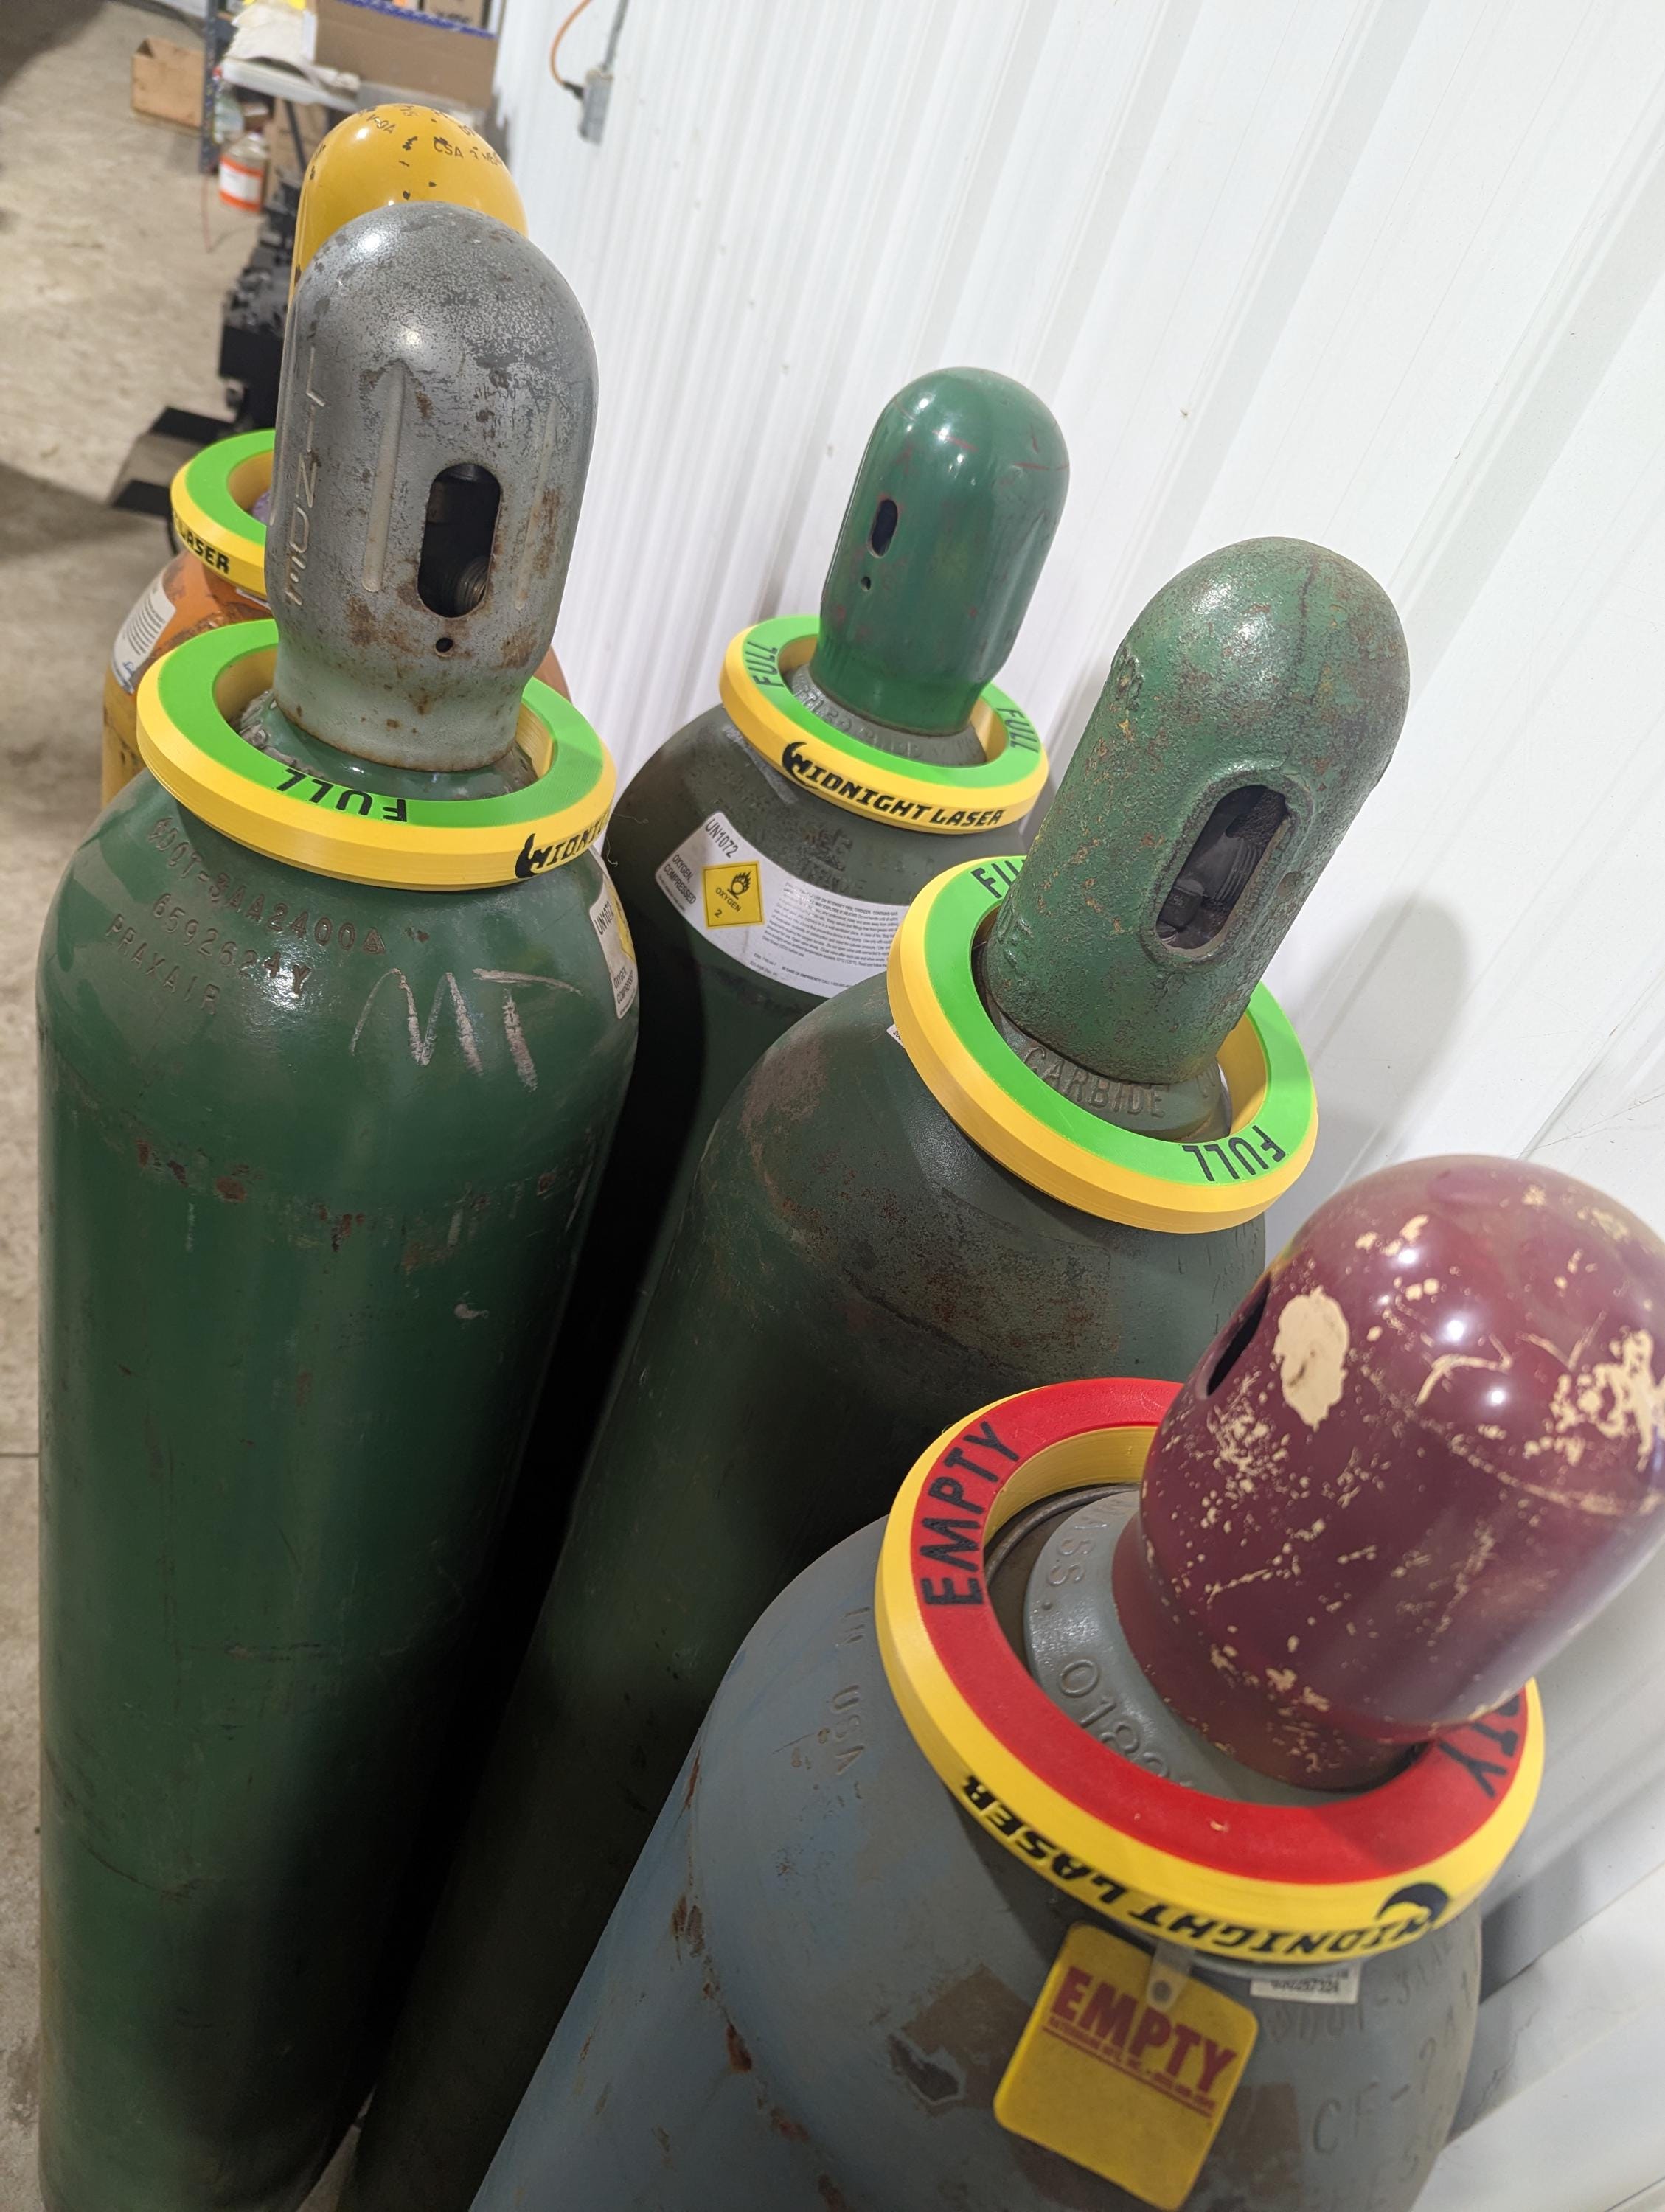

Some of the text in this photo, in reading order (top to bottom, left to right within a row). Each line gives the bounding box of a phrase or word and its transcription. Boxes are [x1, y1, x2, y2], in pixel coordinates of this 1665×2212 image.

[745, 641, 784, 688] FULL
[996, 706, 1040, 753] FULL
[277, 766, 407, 824] FULL
[788, 751, 1007, 827] MIDNIGHT LASER
[705, 818, 739, 858] UN1072
[664, 863, 697, 905] COMPRESSED
[715, 887, 742, 913] OXYGEN
[349, 967, 583, 1093] MT
[1023, 1046, 1166, 1119] CARBIDE
[1181, 1124, 1287, 1183] FULL
[919, 1420, 1021, 1607] EMPTY
[962, 1774, 1127, 1905] LASER
[1049, 1964, 1238, 2096] EMPTY
